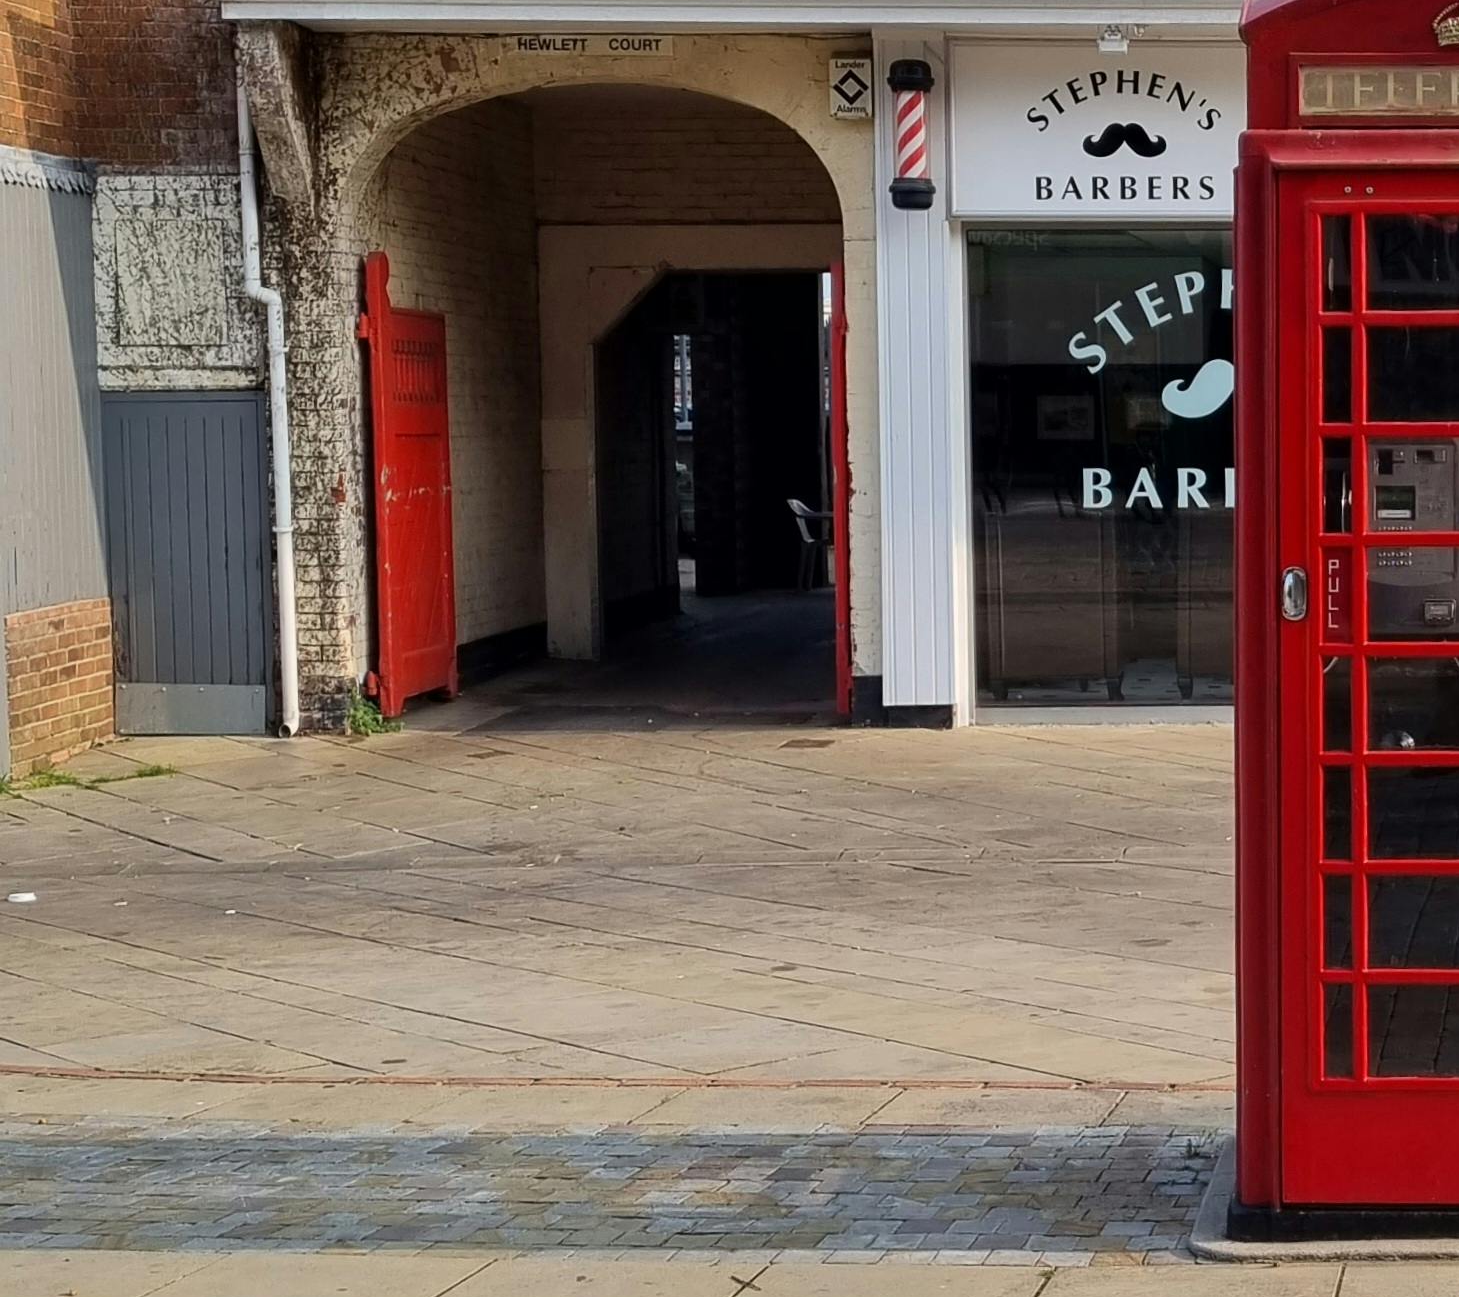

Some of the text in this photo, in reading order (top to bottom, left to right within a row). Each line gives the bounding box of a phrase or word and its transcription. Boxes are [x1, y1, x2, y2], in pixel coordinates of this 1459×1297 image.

[517, 37, 662, 51] HEWLETT COURT
[1027, 70, 1222, 132] STEPHEN'S
[1035, 176, 1214, 200] BARBERS
[1328, 559, 1340, 629] PULL
